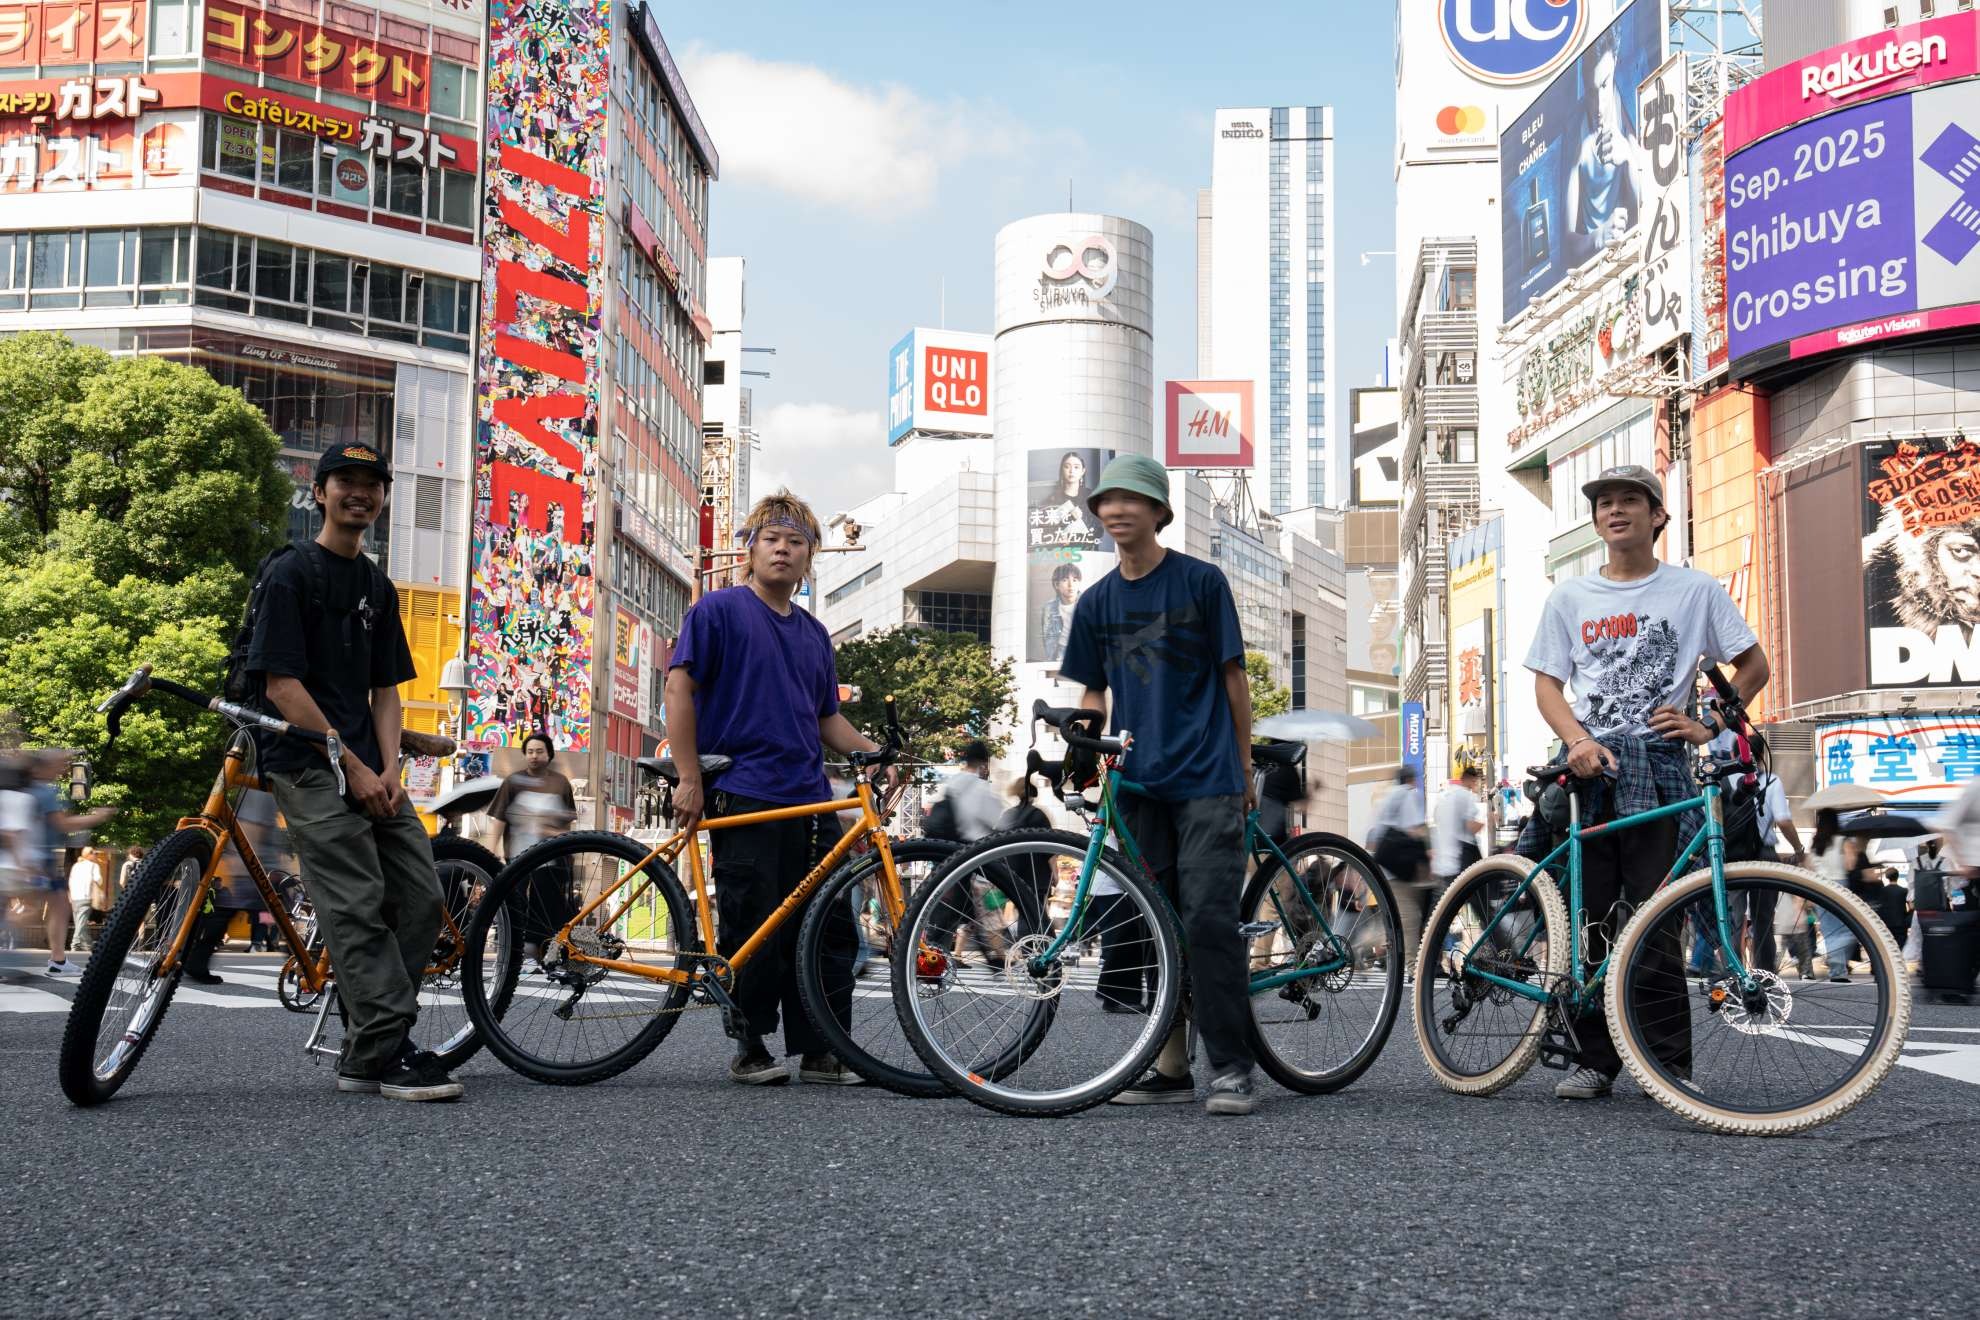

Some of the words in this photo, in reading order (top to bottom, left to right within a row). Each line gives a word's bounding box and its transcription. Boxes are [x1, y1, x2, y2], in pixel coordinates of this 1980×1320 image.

[207, 7, 424, 95] コンタクト
[1802, 34, 1947, 99] Rakuten
[56, 76, 159, 120] ガスト
[358, 117, 457, 169] ガスト
[1222, 129, 1264, 138] INDIGO
[1522, 114, 1544, 145] BLEU
[1518, 141, 1548, 176] CHANEL
[1643, 77, 1682, 331] もんじゃ
[1731, 198, 1882, 271] Shibuya
[1732, 256, 1908, 332] Crossing
[1837, 324, 1882, 343] Rakuten
[1883, 316, 1921, 334] Vision
[932, 354, 977, 381] UNI
[932, 381, 981, 409] QLO
[1187, 408, 1232, 438] H&M
[1582, 612, 1638, 645] CX1000
[1409, 713, 1420, 756] MIZUHO
[1828, 732, 1980, 786] 盛堂書
